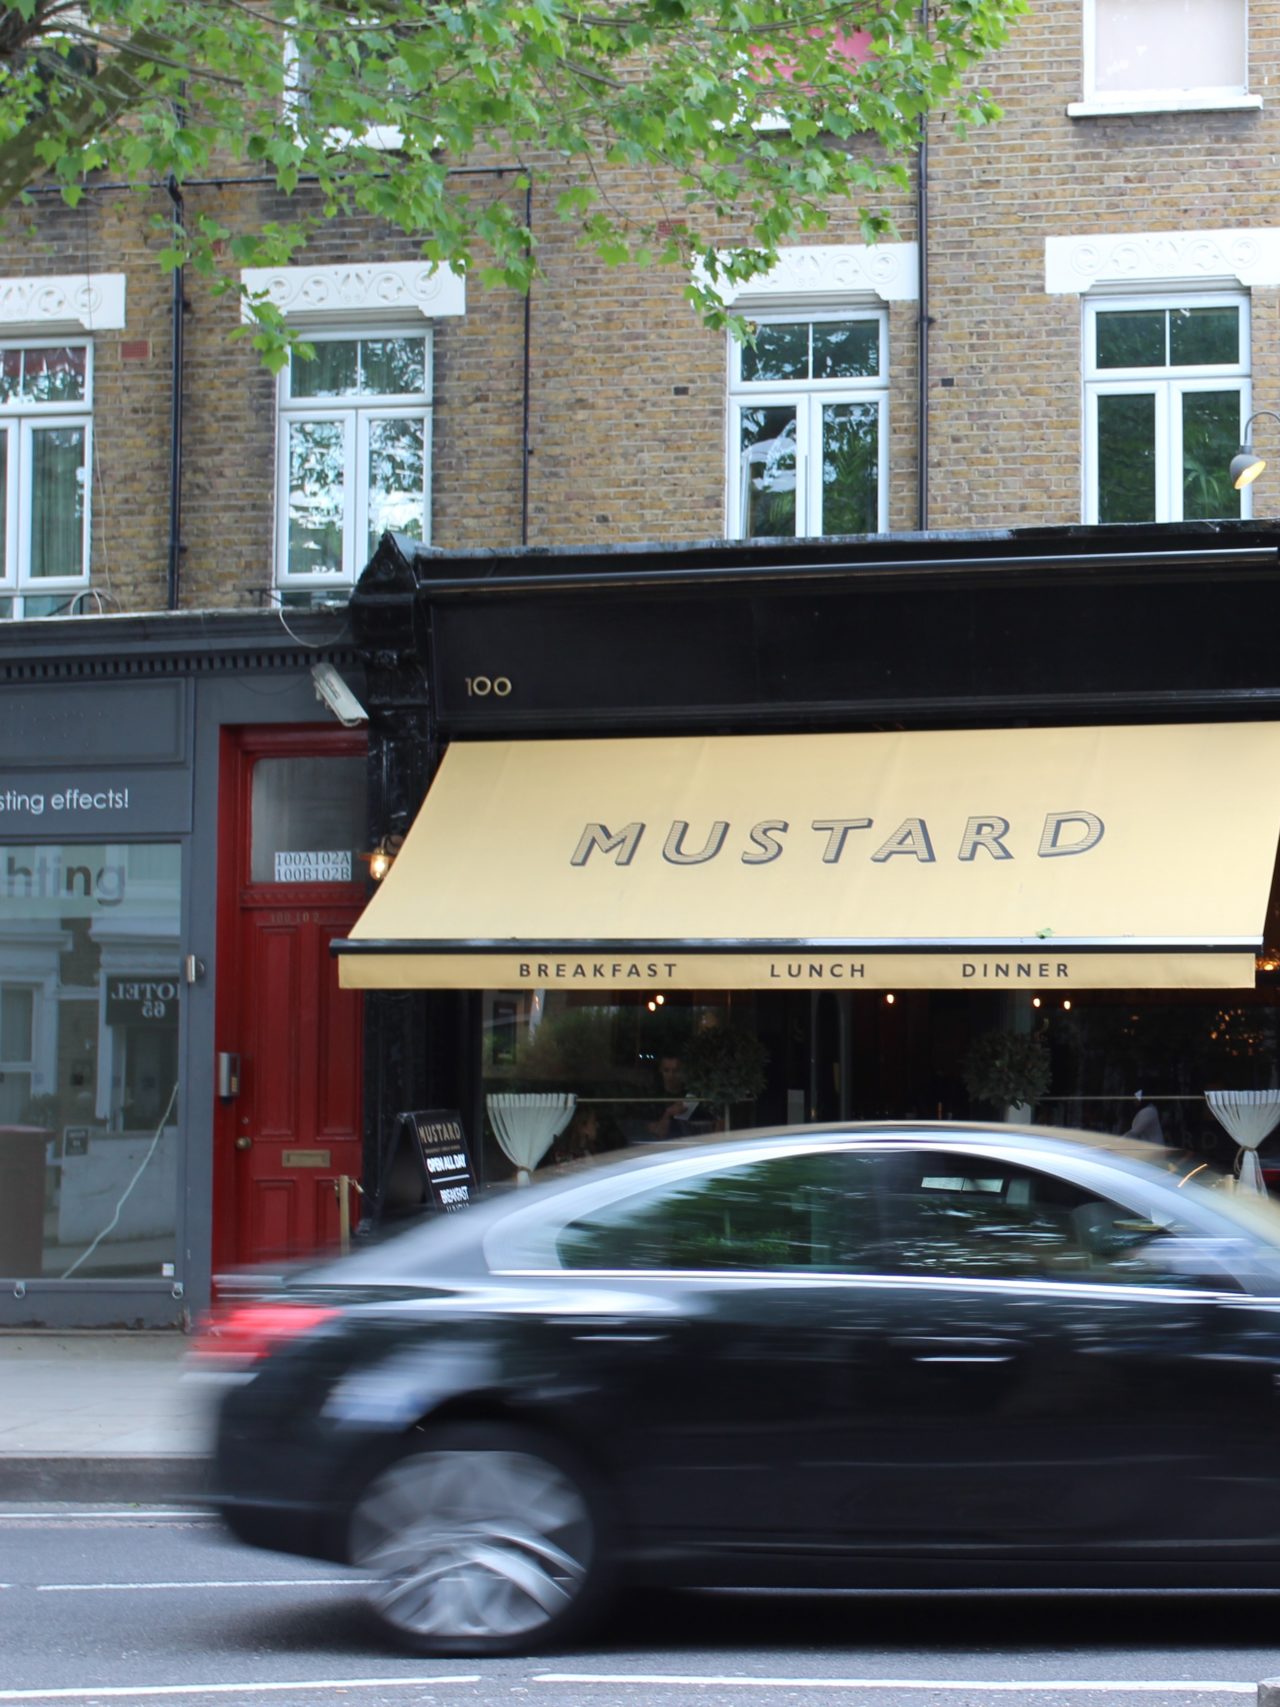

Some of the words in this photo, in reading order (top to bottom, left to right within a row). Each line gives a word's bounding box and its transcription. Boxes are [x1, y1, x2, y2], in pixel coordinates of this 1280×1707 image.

[465, 677, 513, 697] 100
[51, 788, 129, 811] effects!
[570, 810, 1105, 867] MUSTARD
[519, 963, 677, 978] BREAKFAST
[770, 963, 866, 978] LUNCH
[962, 962, 1070, 978] DINNER
[418, 1121, 461, 1144] MUSTARD
[427, 1156, 445, 1173] OPEN
[443, 1155, 456, 1170] ALL
[453, 1153, 467, 1169] DAY
